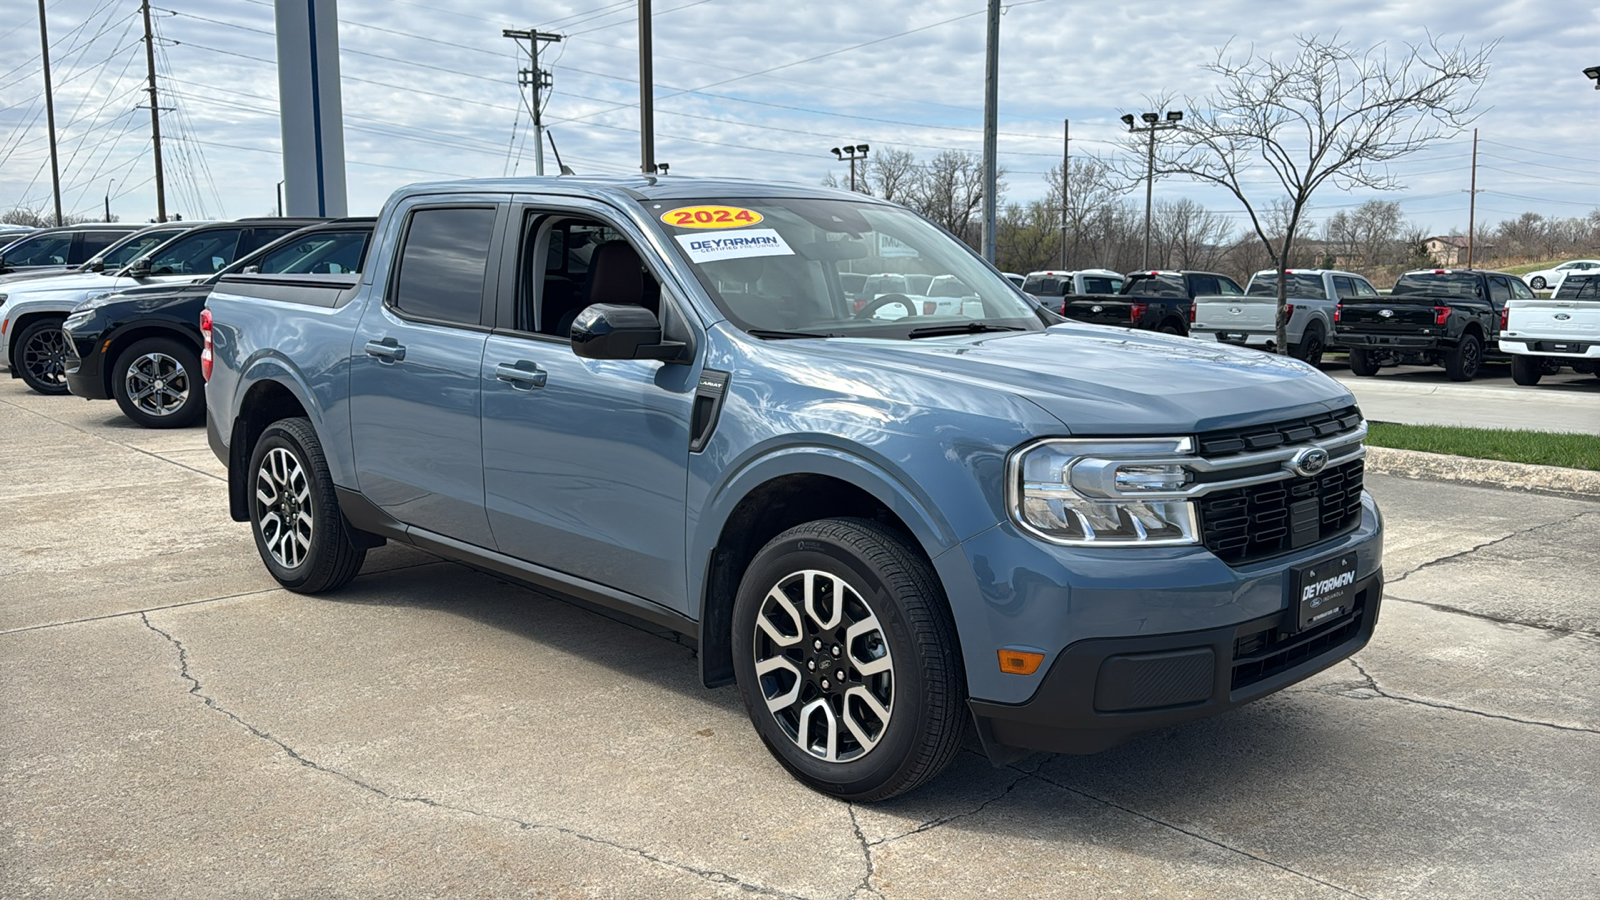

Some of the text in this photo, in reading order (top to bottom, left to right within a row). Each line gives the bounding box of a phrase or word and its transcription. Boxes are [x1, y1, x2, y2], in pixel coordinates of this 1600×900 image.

[674, 210, 754, 225] 2024
[690, 236, 777, 250] DEYARMAN
[700, 243, 780, 254] CERTIFIED PRE-OWNED
[699, 380, 722, 388] LARIAT
[1306, 454, 1325, 470] Ford
[1302, 571, 1355, 601] DEYARMAN
